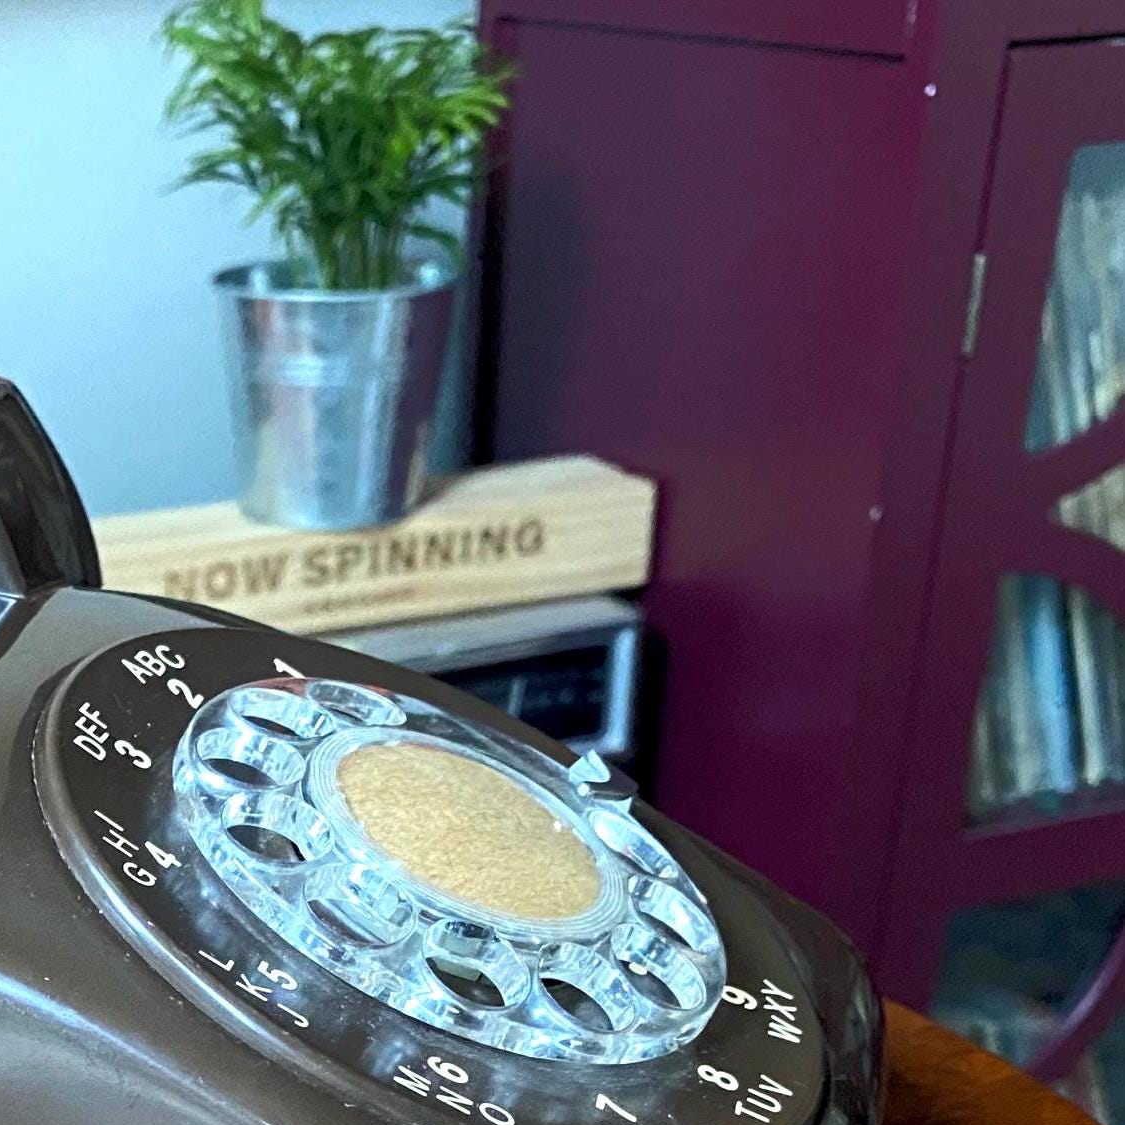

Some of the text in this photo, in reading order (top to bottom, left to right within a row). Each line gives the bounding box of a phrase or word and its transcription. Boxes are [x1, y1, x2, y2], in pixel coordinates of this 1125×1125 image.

[163, 517, 546, 600] NOW SPINNING
[121, 644, 185, 684] ABC
[273, 658, 306, 678] 1
[167, 678, 204, 709] 2
[73, 702, 109, 761] DEF
[114, 739, 152, 770] 3
[144, 841, 182, 869] 4
[257, 960, 298, 991] 5
[722, 985, 758, 1011] 9
[760, 978, 803, 1044] WXY
[427, 1056, 469, 1084] 6
[697, 1065, 739, 1091] 8
[595, 1093, 637, 1123] 7
[734, 1074, 794, 1123] TUV
